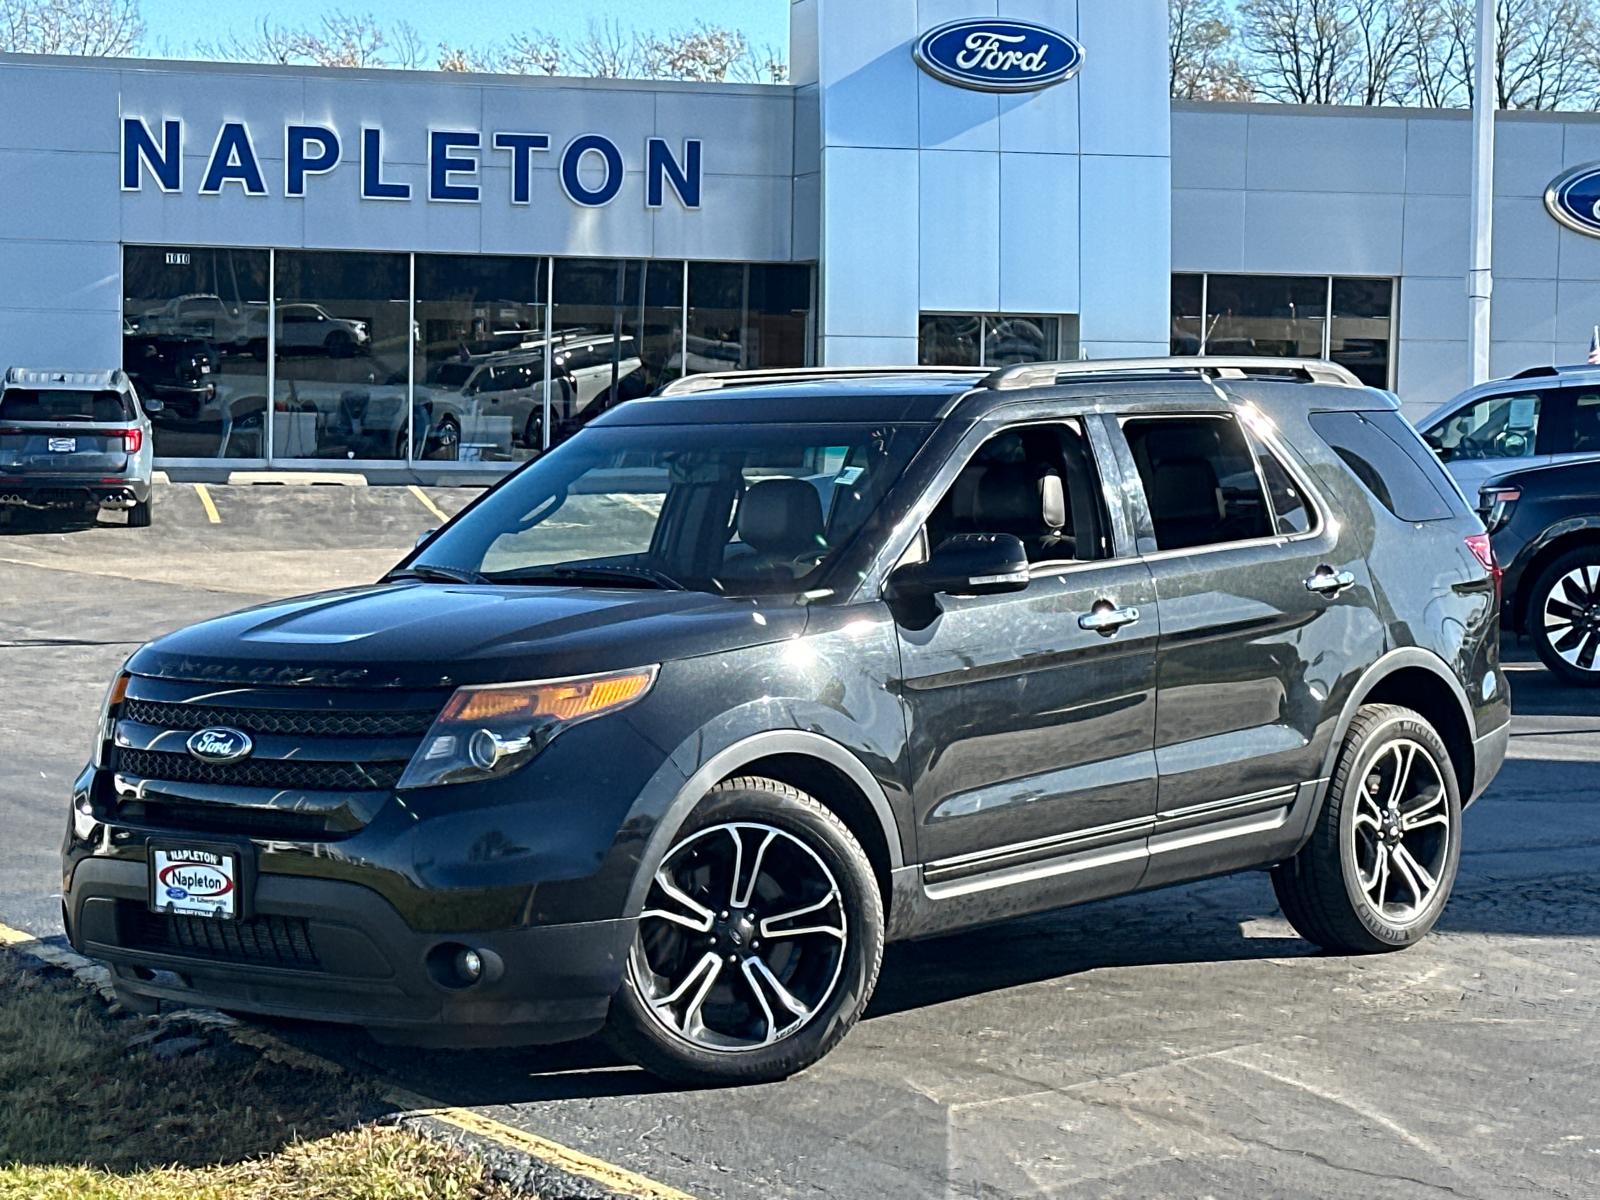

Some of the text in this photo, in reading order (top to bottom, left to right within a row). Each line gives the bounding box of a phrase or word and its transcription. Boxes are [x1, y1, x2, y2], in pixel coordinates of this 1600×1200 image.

[956, 32, 1049, 72] Ford
[119, 115, 702, 209] NAPLETON
[167, 253, 189, 264] 1010
[197, 731, 234, 755] Ford
[170, 850, 217, 864] NAPLETON
[172, 870, 221, 890] Napleton
[1359, 904, 1406, 941] MICHELIN
